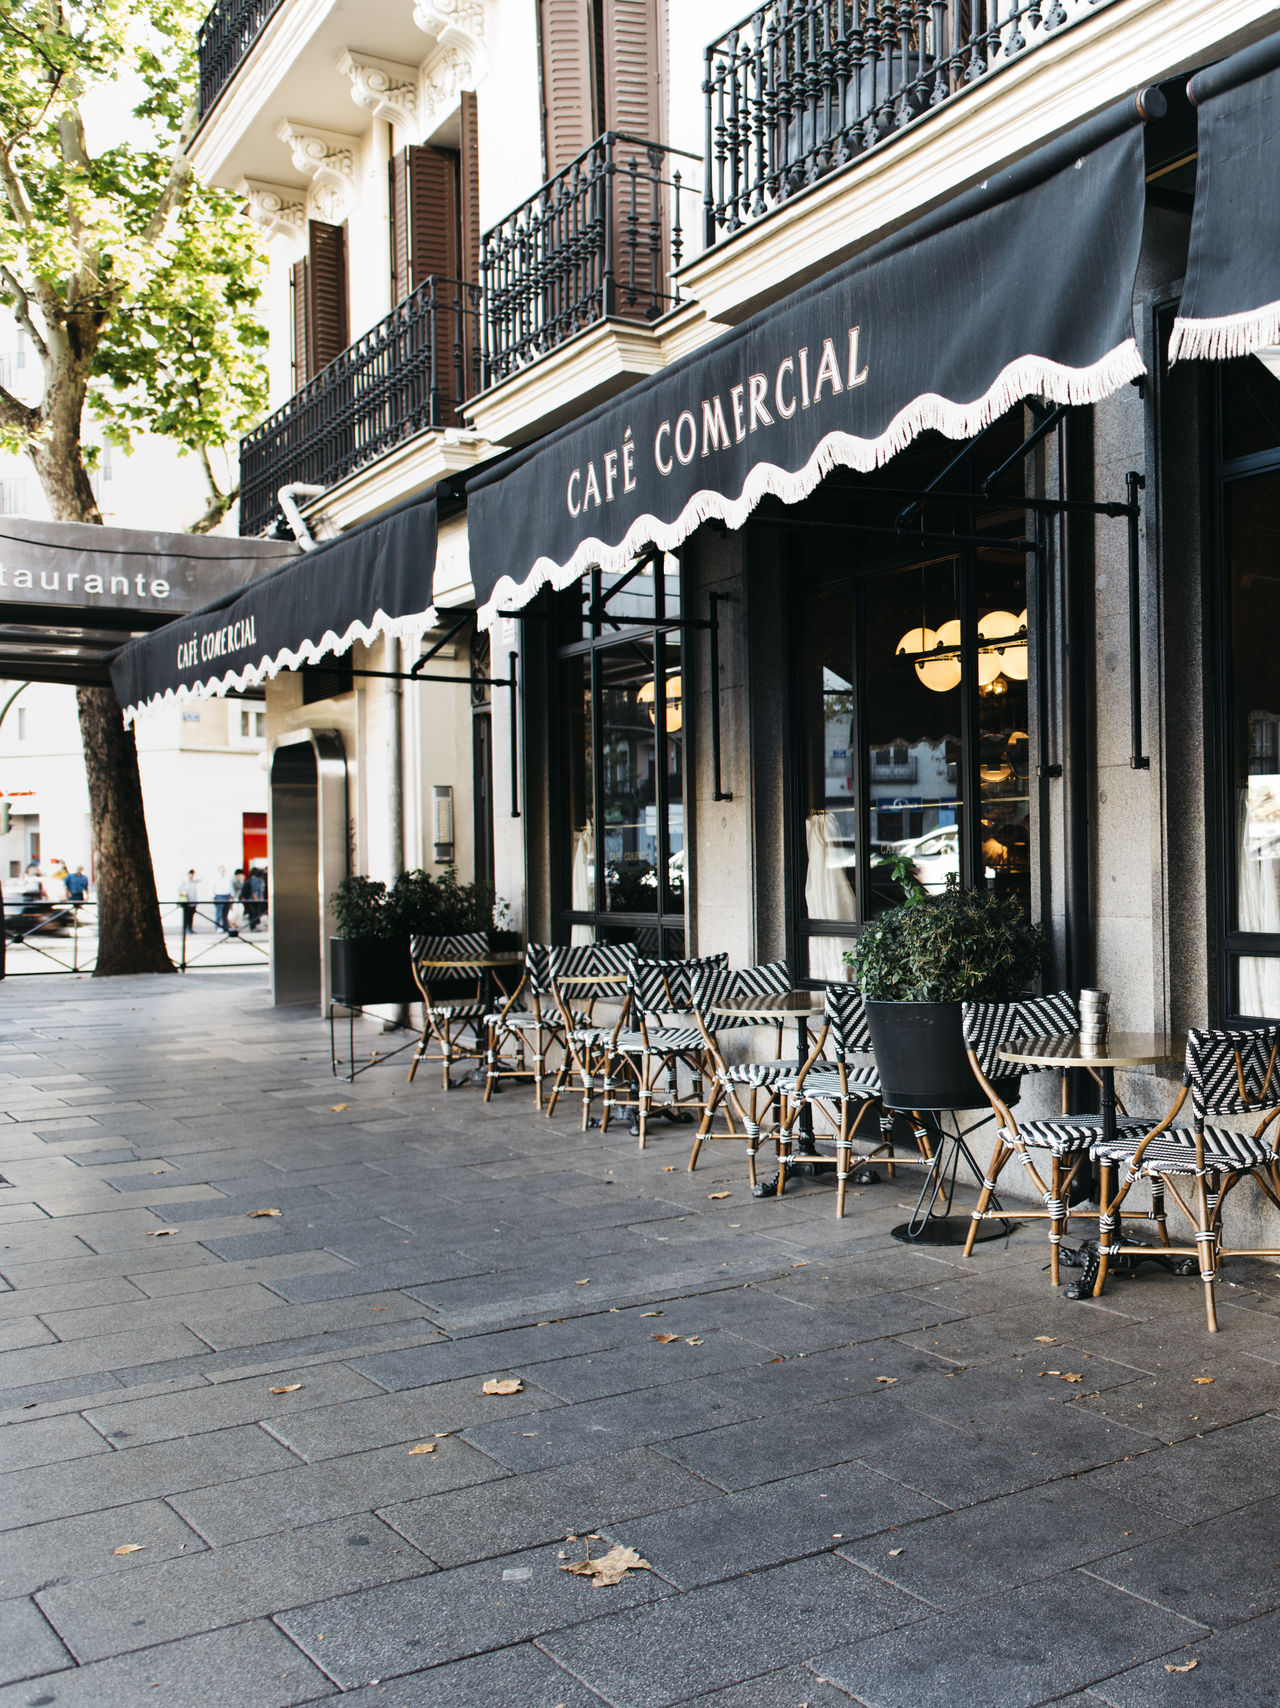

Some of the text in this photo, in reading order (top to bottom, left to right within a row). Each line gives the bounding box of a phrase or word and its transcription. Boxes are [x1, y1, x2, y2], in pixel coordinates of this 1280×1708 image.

[566, 325, 869, 518] CAFÉ COMERCIAL
[177, 614, 257, 670] CAFÉ COMERCIAL
